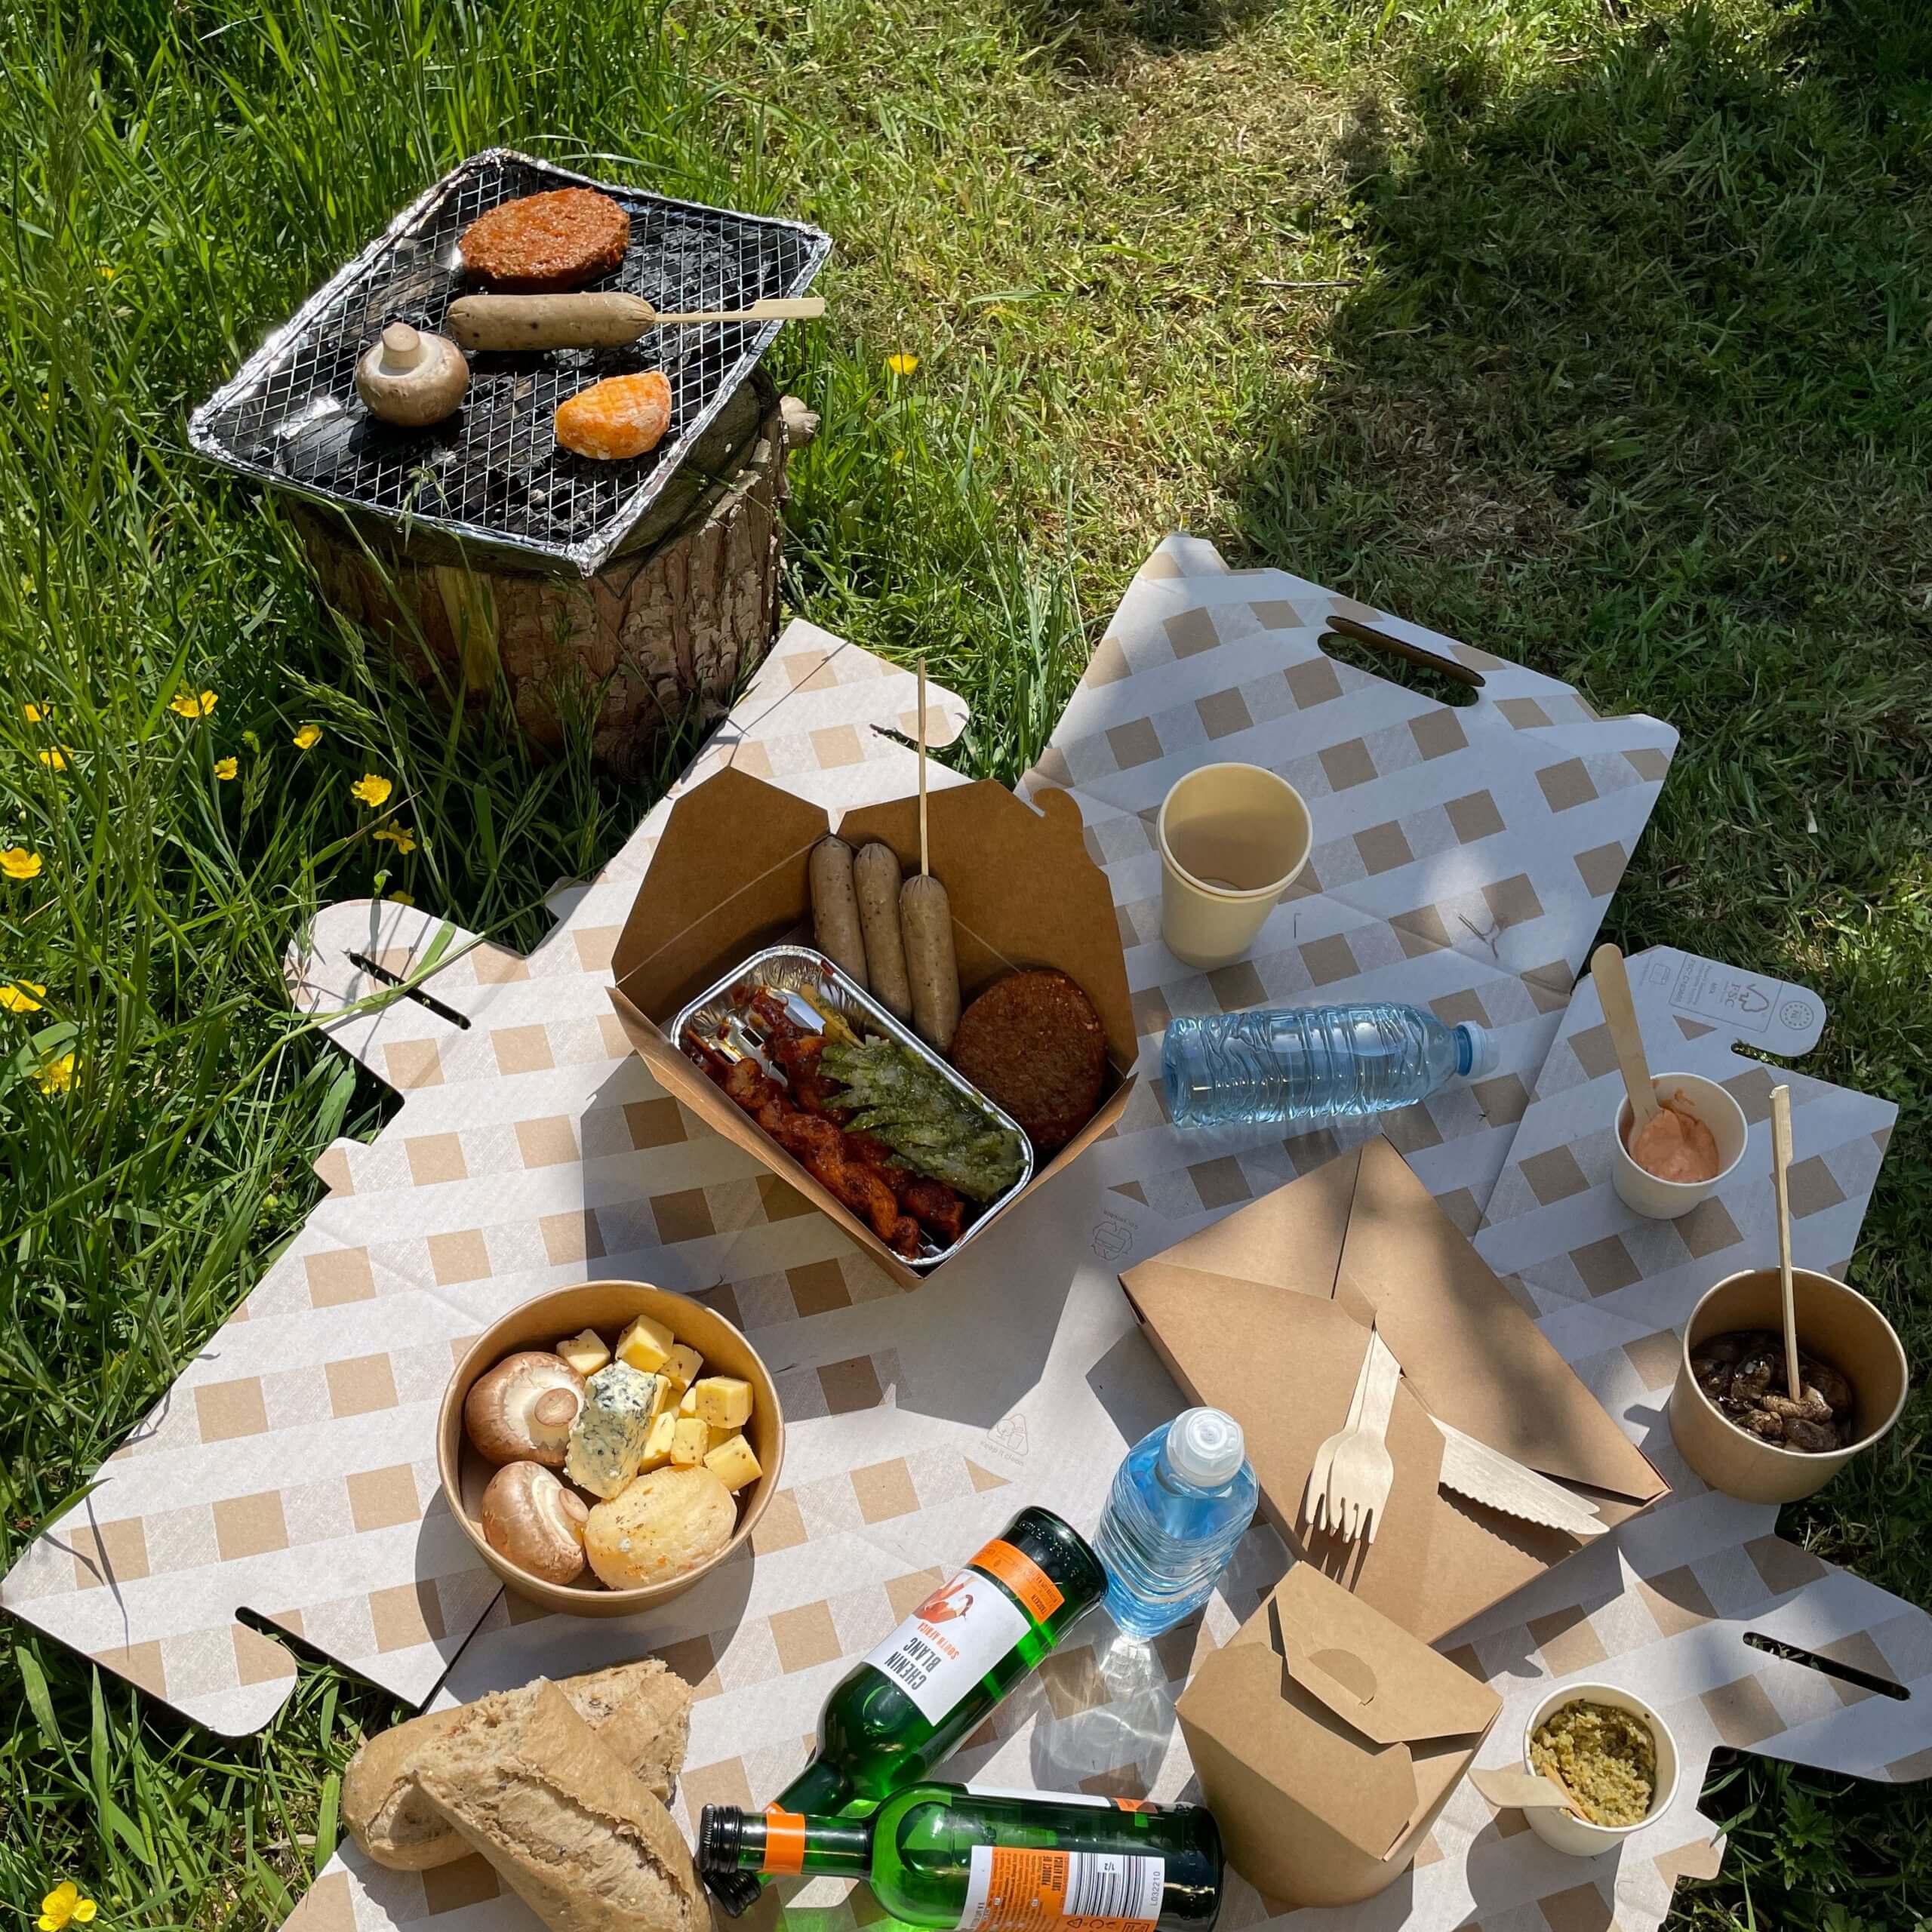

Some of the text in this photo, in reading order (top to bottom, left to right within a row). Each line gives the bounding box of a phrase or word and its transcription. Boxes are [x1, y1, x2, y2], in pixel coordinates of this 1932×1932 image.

[1725, 983, 1740, 1008] FSC
[903, 1637, 942, 1672] BLANC
[918, 1622, 959, 1660] SOUTH AFRICA
[884, 1651, 927, 1690] CHENIN
[1041, 1863, 1052, 1885] PRODUCT
[1052, 1857, 1063, 1891] SOUTH AFRICA
[1104, 1862, 1115, 1871] 1/2
[1150, 1871, 1160, 1906] L032210
